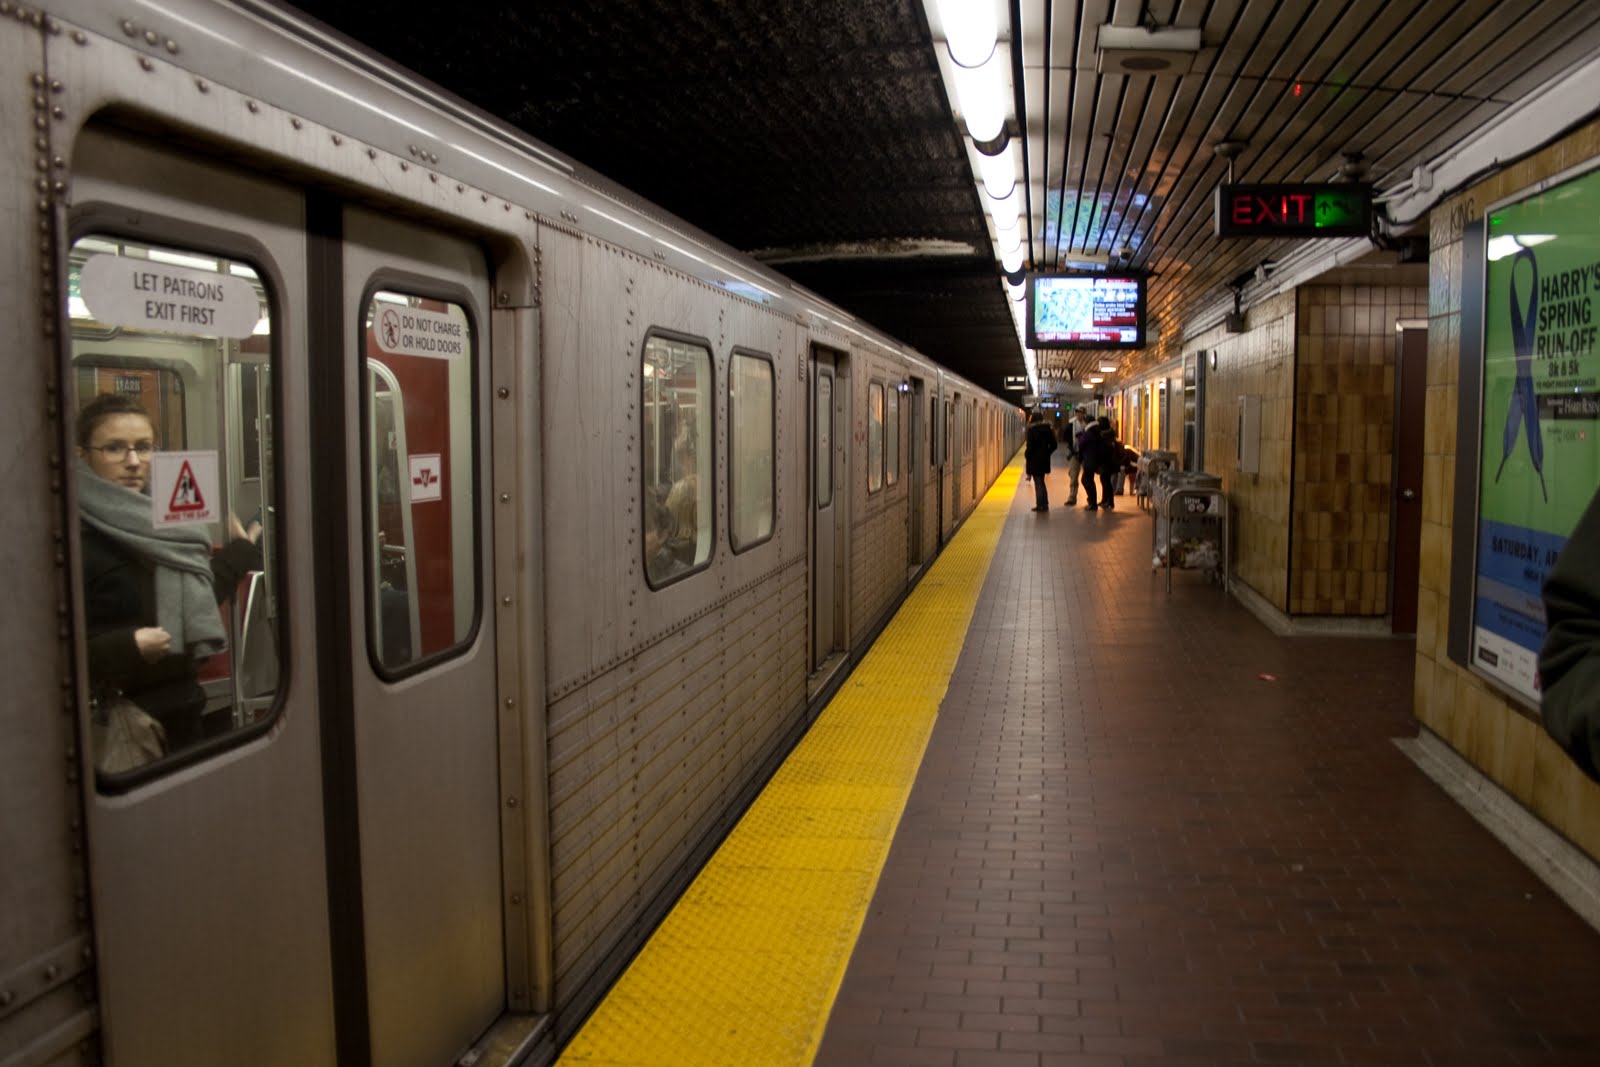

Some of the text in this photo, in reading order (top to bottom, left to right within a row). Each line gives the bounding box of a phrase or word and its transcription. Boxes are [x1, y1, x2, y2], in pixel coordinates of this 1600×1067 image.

[1231, 194, 1312, 225] EXIT
[1450, 199, 1475, 230] KING
[133, 271, 224, 303] LET PATRONS
[1541, 263, 1600, 304] HARRY'S
[145, 300, 215, 325] EXIT FIRST
[402, 315, 461, 337] DO NOT CHARGE
[1538, 298, 1592, 332] SPRING
[402, 335, 461, 354] OR HOLD DOORS
[1536, 326, 1598, 361] RUN-OFF
